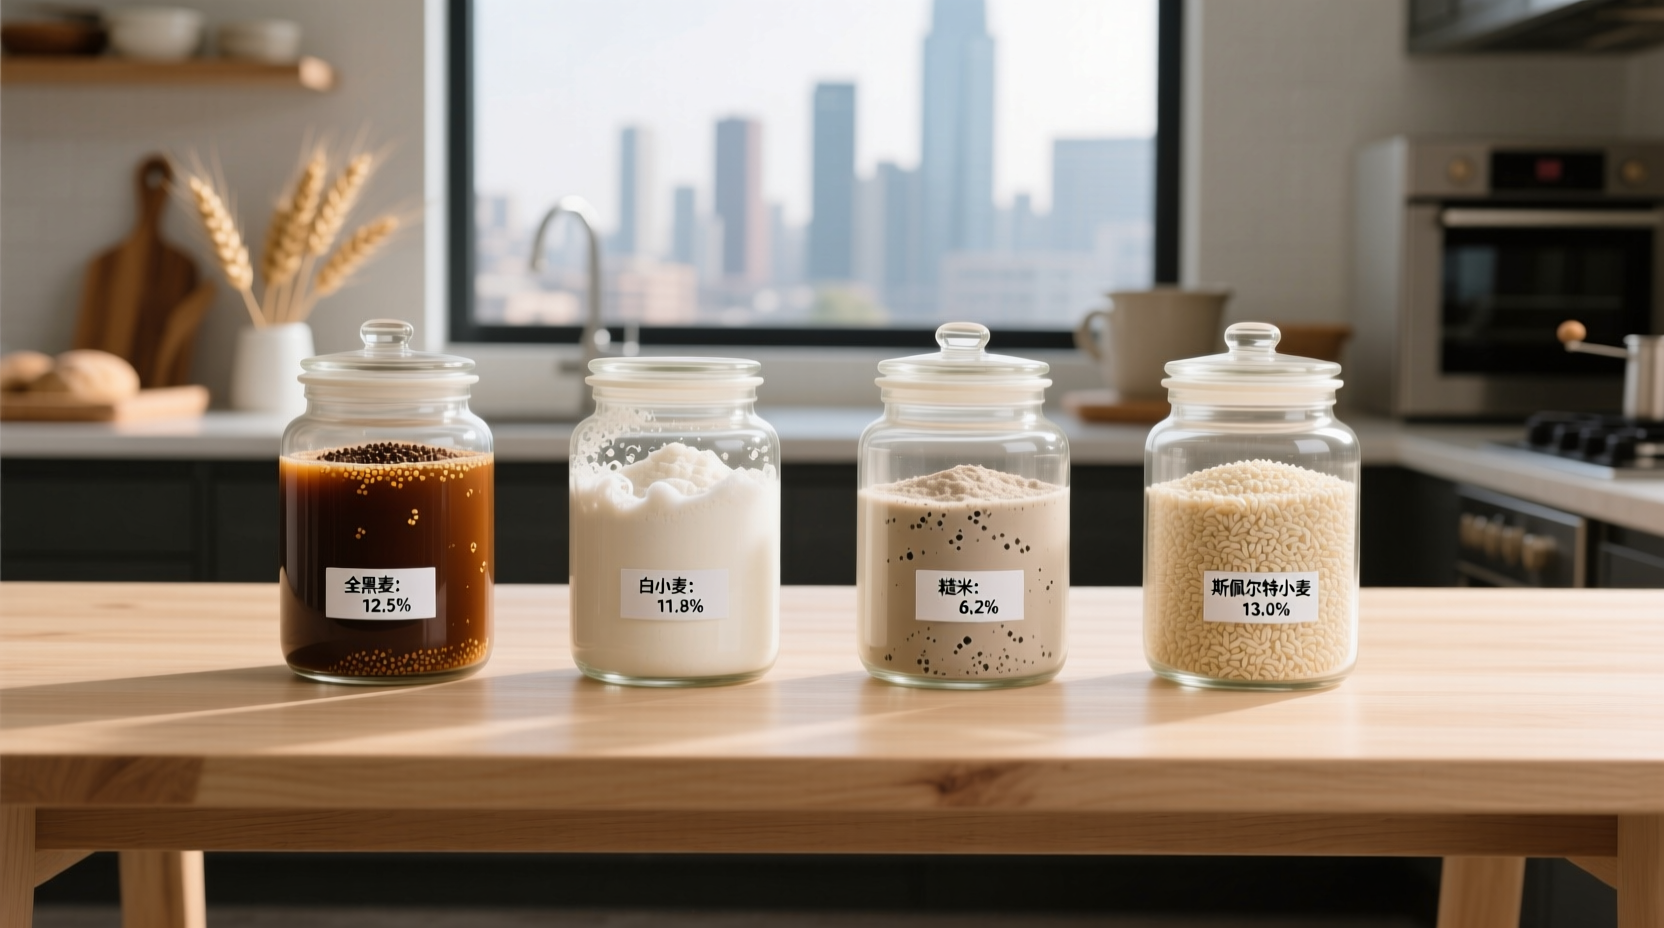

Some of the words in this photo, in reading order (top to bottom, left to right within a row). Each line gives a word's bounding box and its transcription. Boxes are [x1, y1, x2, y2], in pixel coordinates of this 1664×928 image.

[639, 576, 694, 595] 白小麦：
[1210, 577, 1311, 598] 斯佩尔特小麦
[362, 597, 412, 613] 12.5%
[657, 598, 704, 613] 11.8%
[1242, 601, 1291, 617] 13.0%
